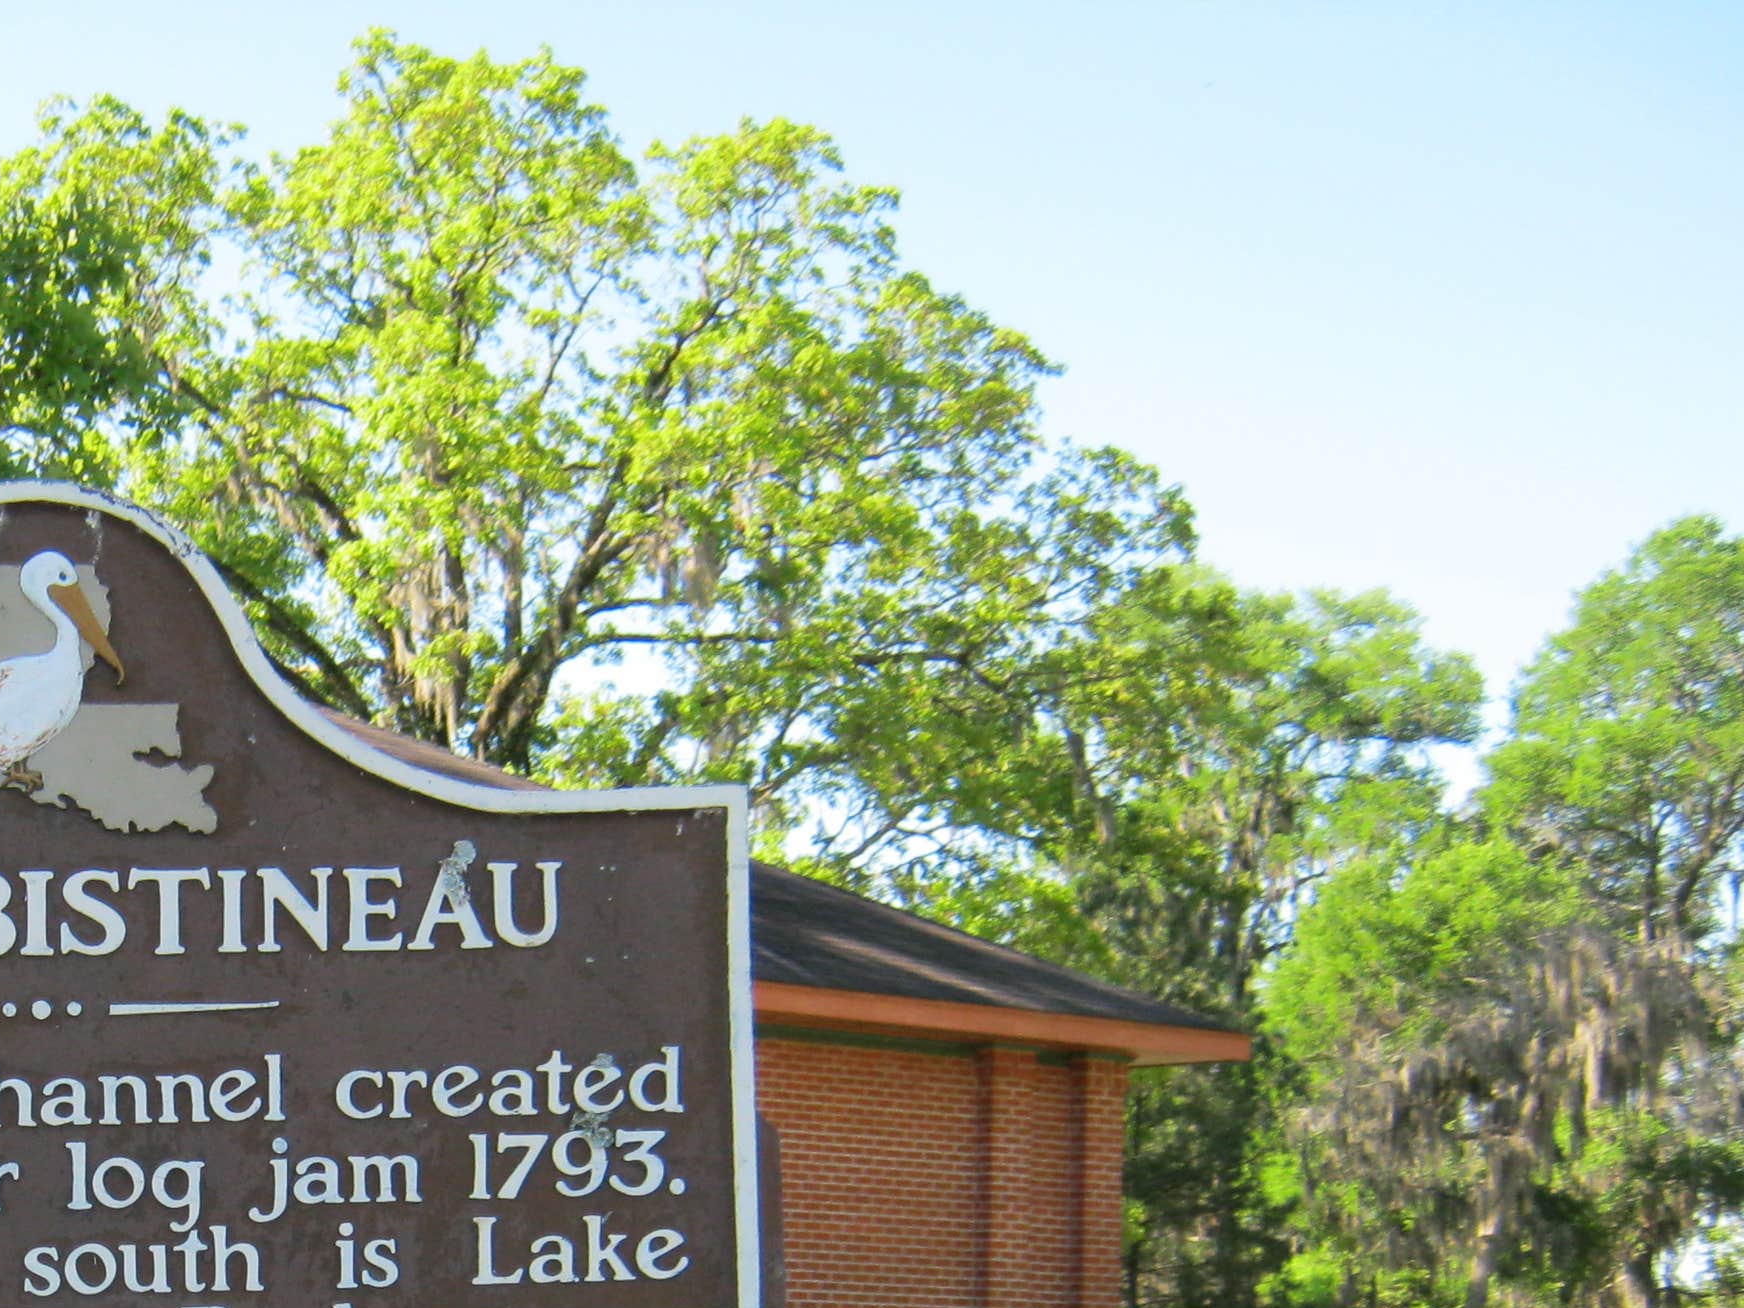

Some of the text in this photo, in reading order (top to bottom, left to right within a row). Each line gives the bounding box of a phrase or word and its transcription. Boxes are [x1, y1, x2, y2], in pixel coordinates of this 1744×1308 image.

[334, 1045, 685, 1120] created
[64, 1140, 206, 1234] log
[246, 1136, 424, 1224] jam
[467, 1127, 687, 1201] 1793.
[22, 1224, 266, 1298] south
[334, 1221, 400, 1290] is
[470, 1213, 690, 1286] Lake
